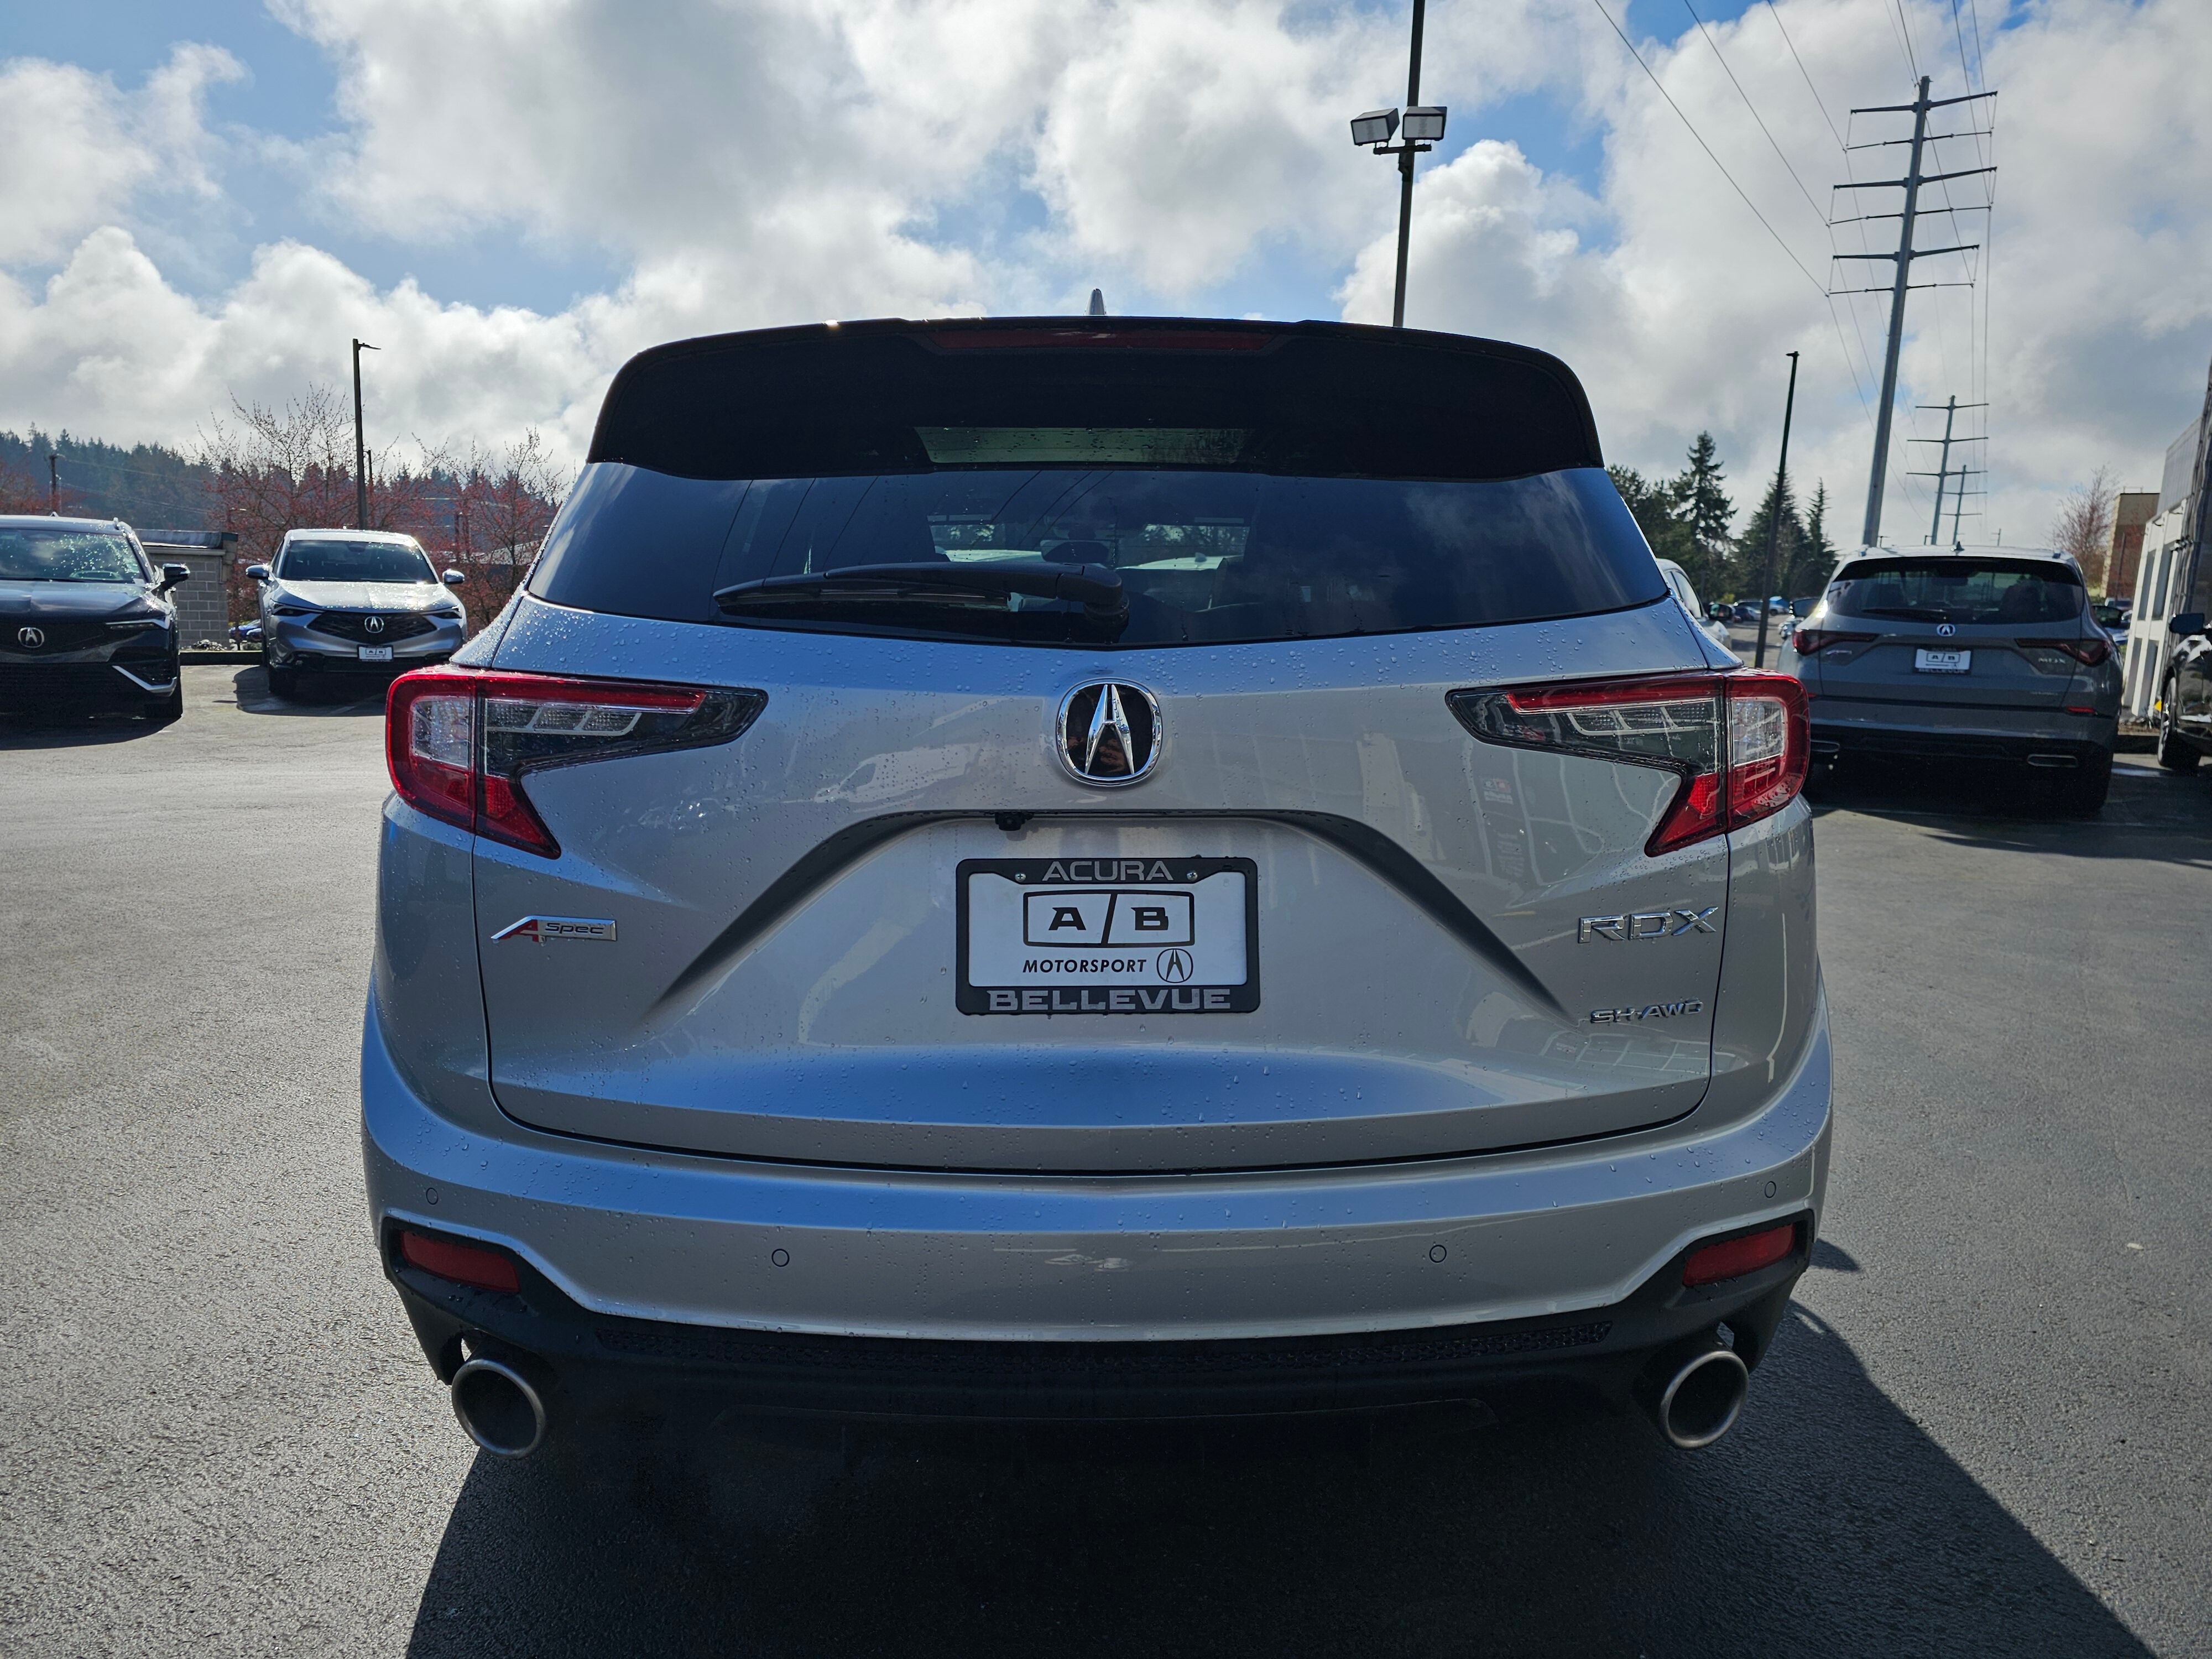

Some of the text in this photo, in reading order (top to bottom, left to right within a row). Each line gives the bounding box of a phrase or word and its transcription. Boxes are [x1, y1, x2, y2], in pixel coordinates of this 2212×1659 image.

[1042, 860, 1173, 881] ACURA
[1578, 906, 1719, 943] RDX
[1022, 959, 1147, 973] MOTORSPORT
[987, 988, 1231, 1011] BELLEVUE
[1590, 998, 1704, 1023] SH-AWD
